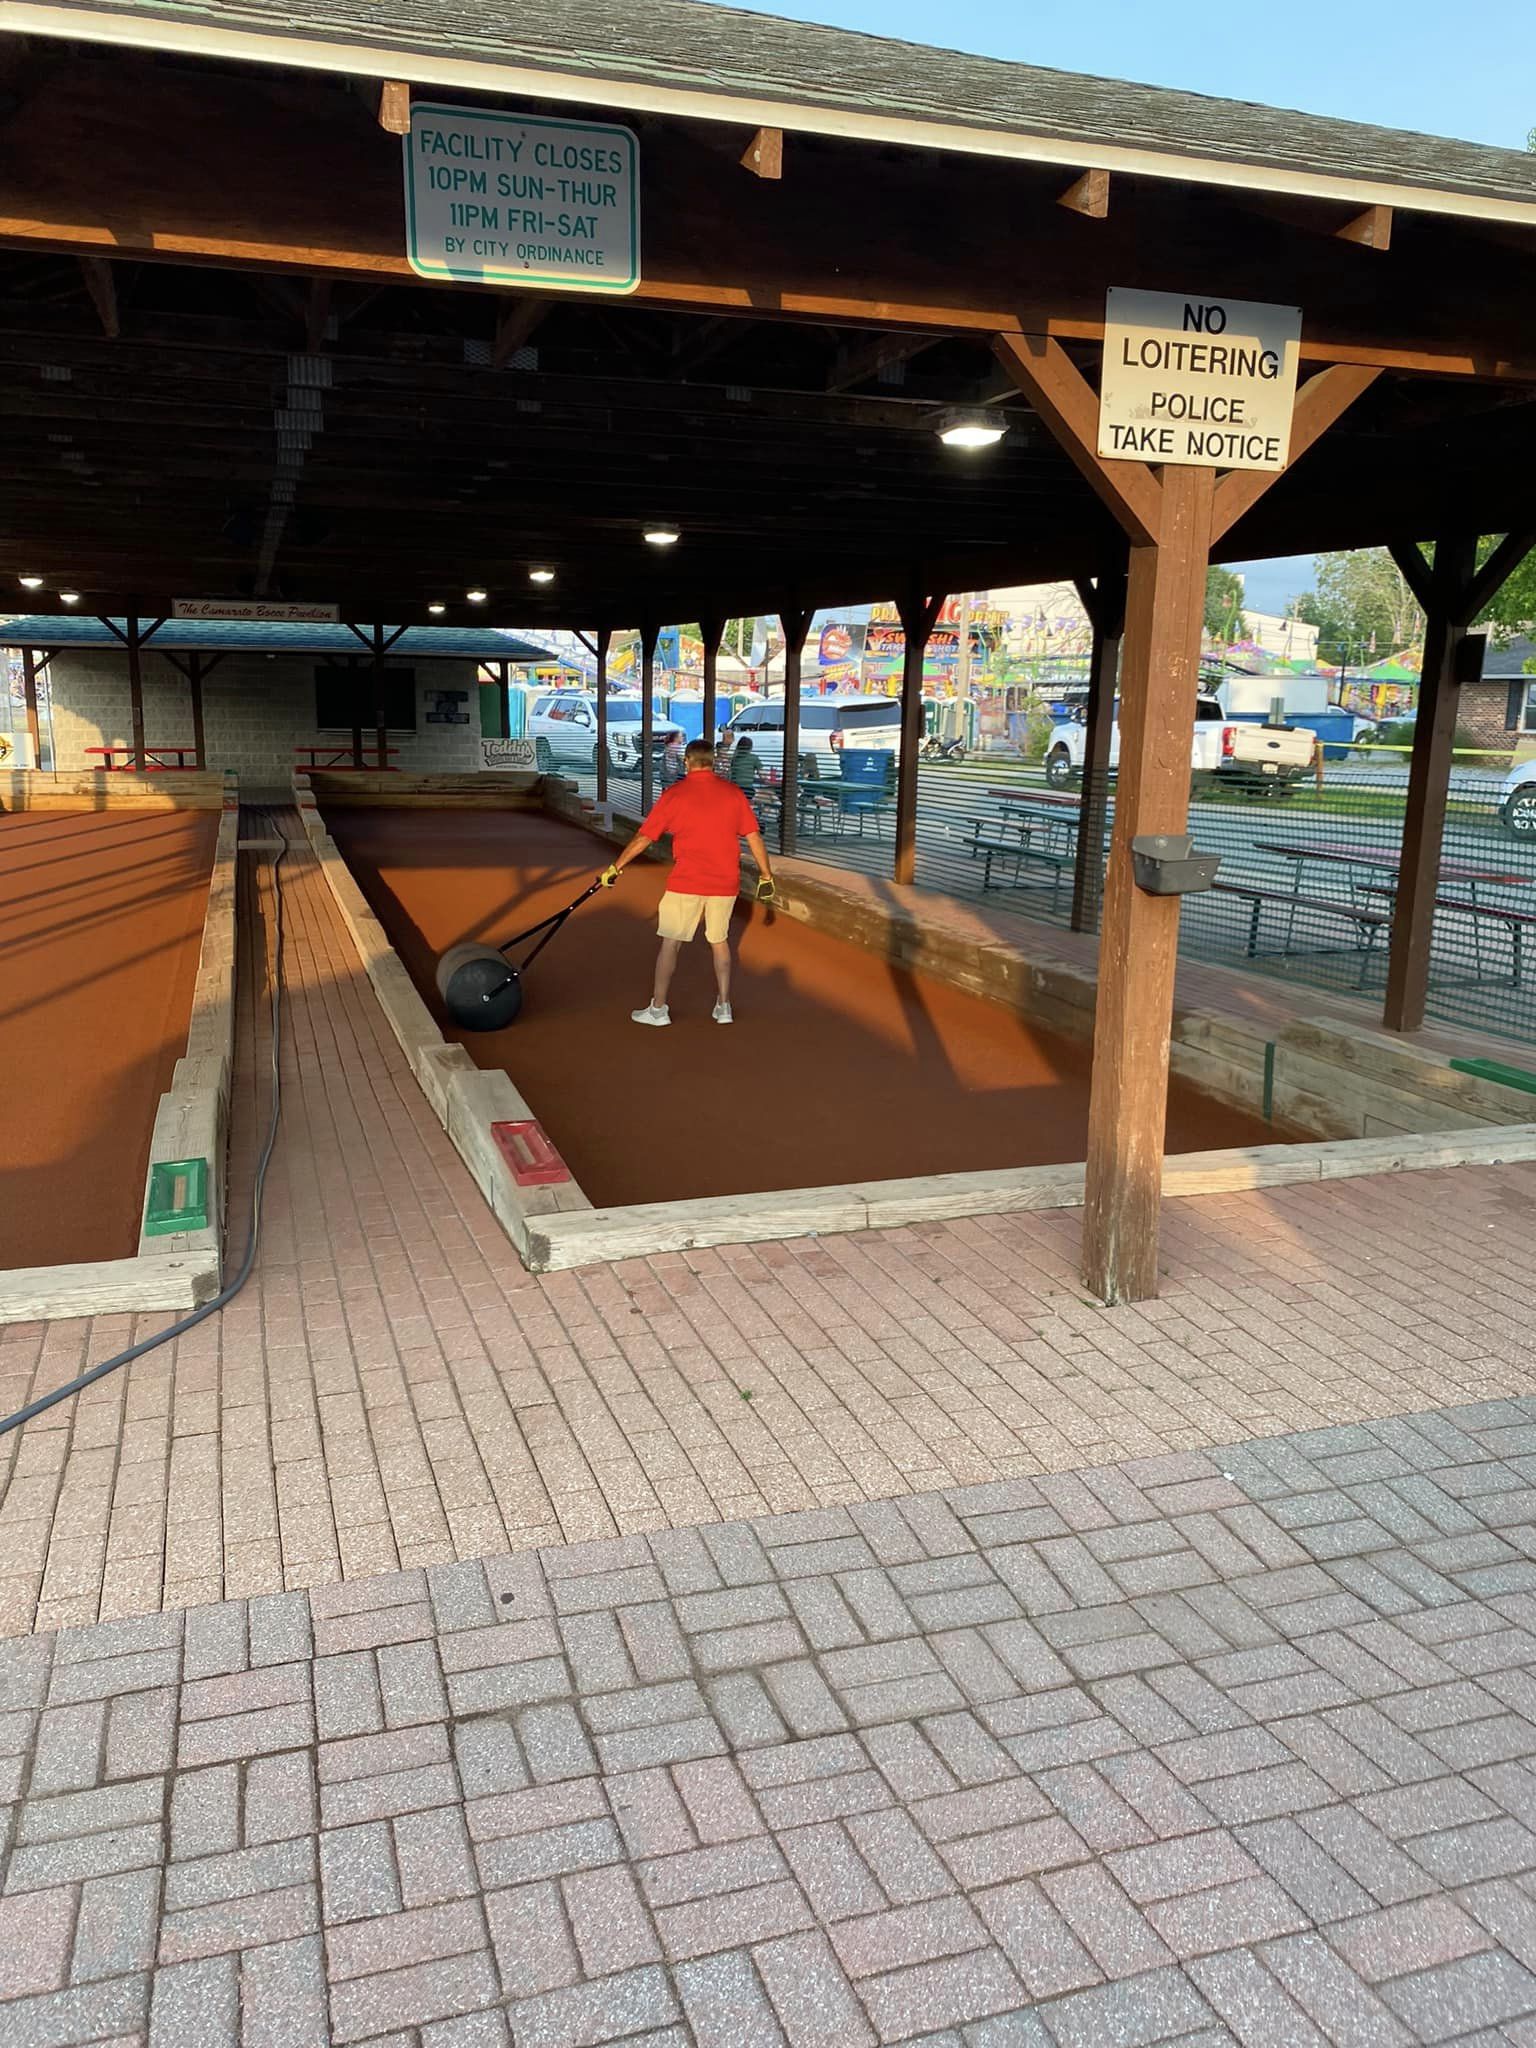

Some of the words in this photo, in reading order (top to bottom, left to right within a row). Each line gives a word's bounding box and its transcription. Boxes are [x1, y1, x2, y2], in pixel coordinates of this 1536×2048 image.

[420, 130, 523, 162] FACILITY
[535, 143, 622, 174] CLOSES
[429, 166, 487, 194] 10PM
[497, 173, 617, 207] SUN-THUR
[450, 203, 498, 230] 11PM
[508, 209, 598, 239] FRI-SAT
[445, 237, 465, 253] BY
[473, 239, 509, 257] CITY
[517, 243, 604, 266] ORDINANCE
[1182, 303, 1227, 335] NO
[1122, 337, 1279, 379] LOITERING
[1151, 392, 1245, 424] POLICE
[1109, 425, 1175, 453] TAKE
[1187, 431, 1281, 461] NOTICE
[178, 603, 198, 615] The
[481, 739, 533, 758] Teddy's
